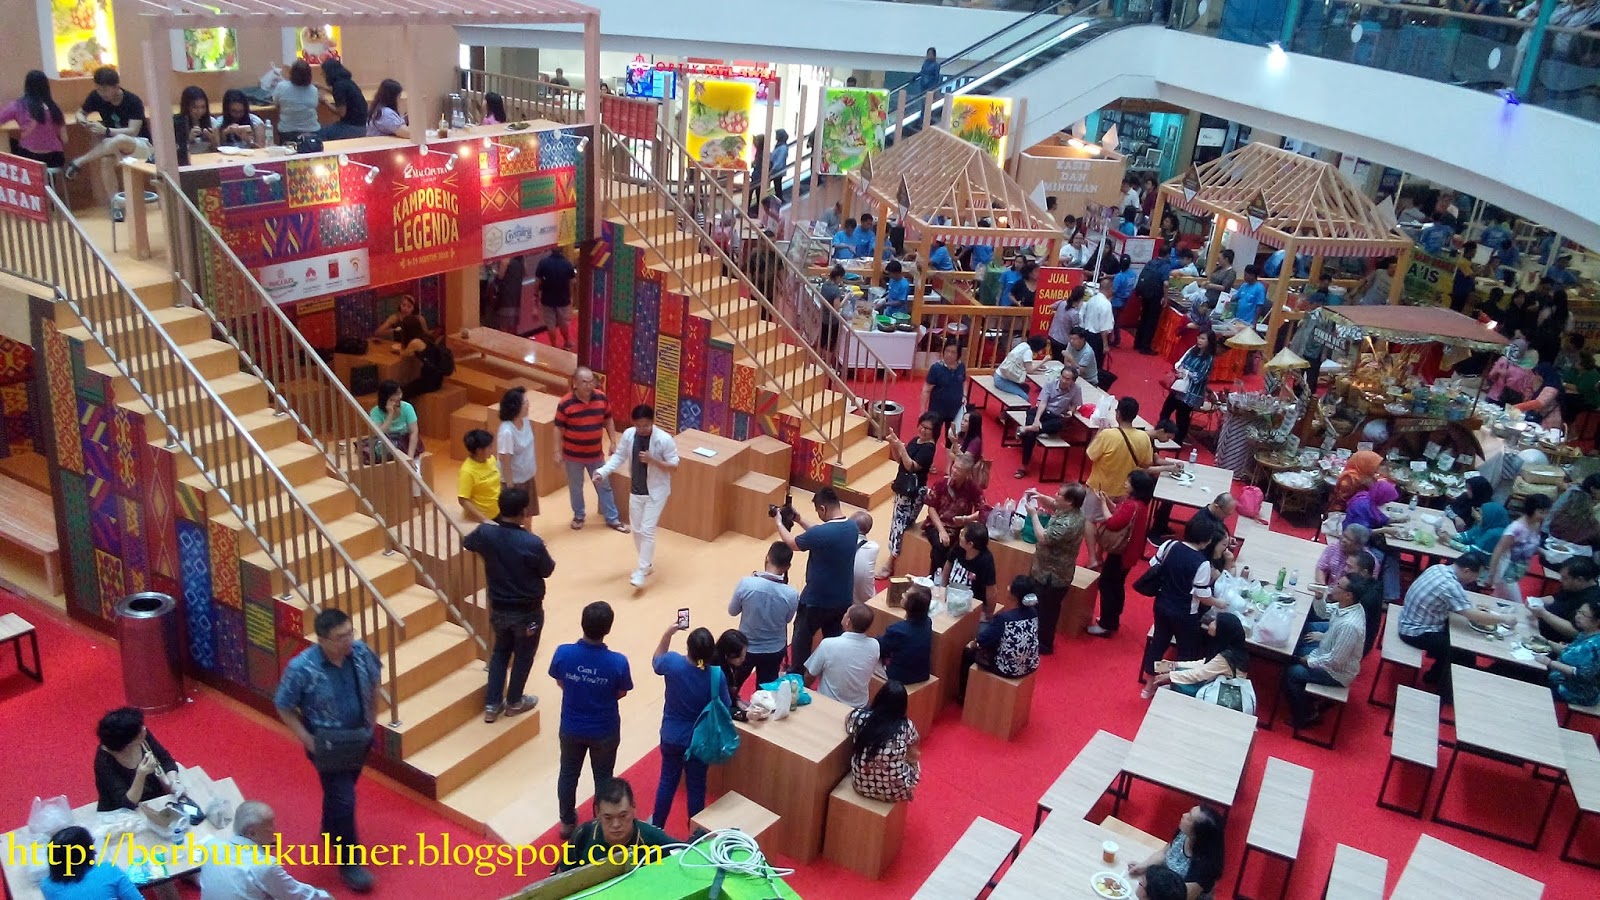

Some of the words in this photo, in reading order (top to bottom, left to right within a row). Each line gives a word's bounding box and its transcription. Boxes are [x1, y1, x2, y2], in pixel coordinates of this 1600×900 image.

[655, 61, 700, 74] OPTIK
[704, 65, 777, 80] MELAWAI
[1061, 171, 1087, 182] DAN
[1043, 181, 1099, 194] MINUMAN
[393, 187, 459, 226] KAMPOENG
[394, 212, 459, 254] LEGENDA
[1047, 273, 1070, 285] JUAL
[1038, 288, 1073, 301] SAMBA
[577, 665, 593, 675] Can
[593, 668, 598, 676] I
[565, 672, 581, 683] Help
[581, 674, 609, 686] You???
